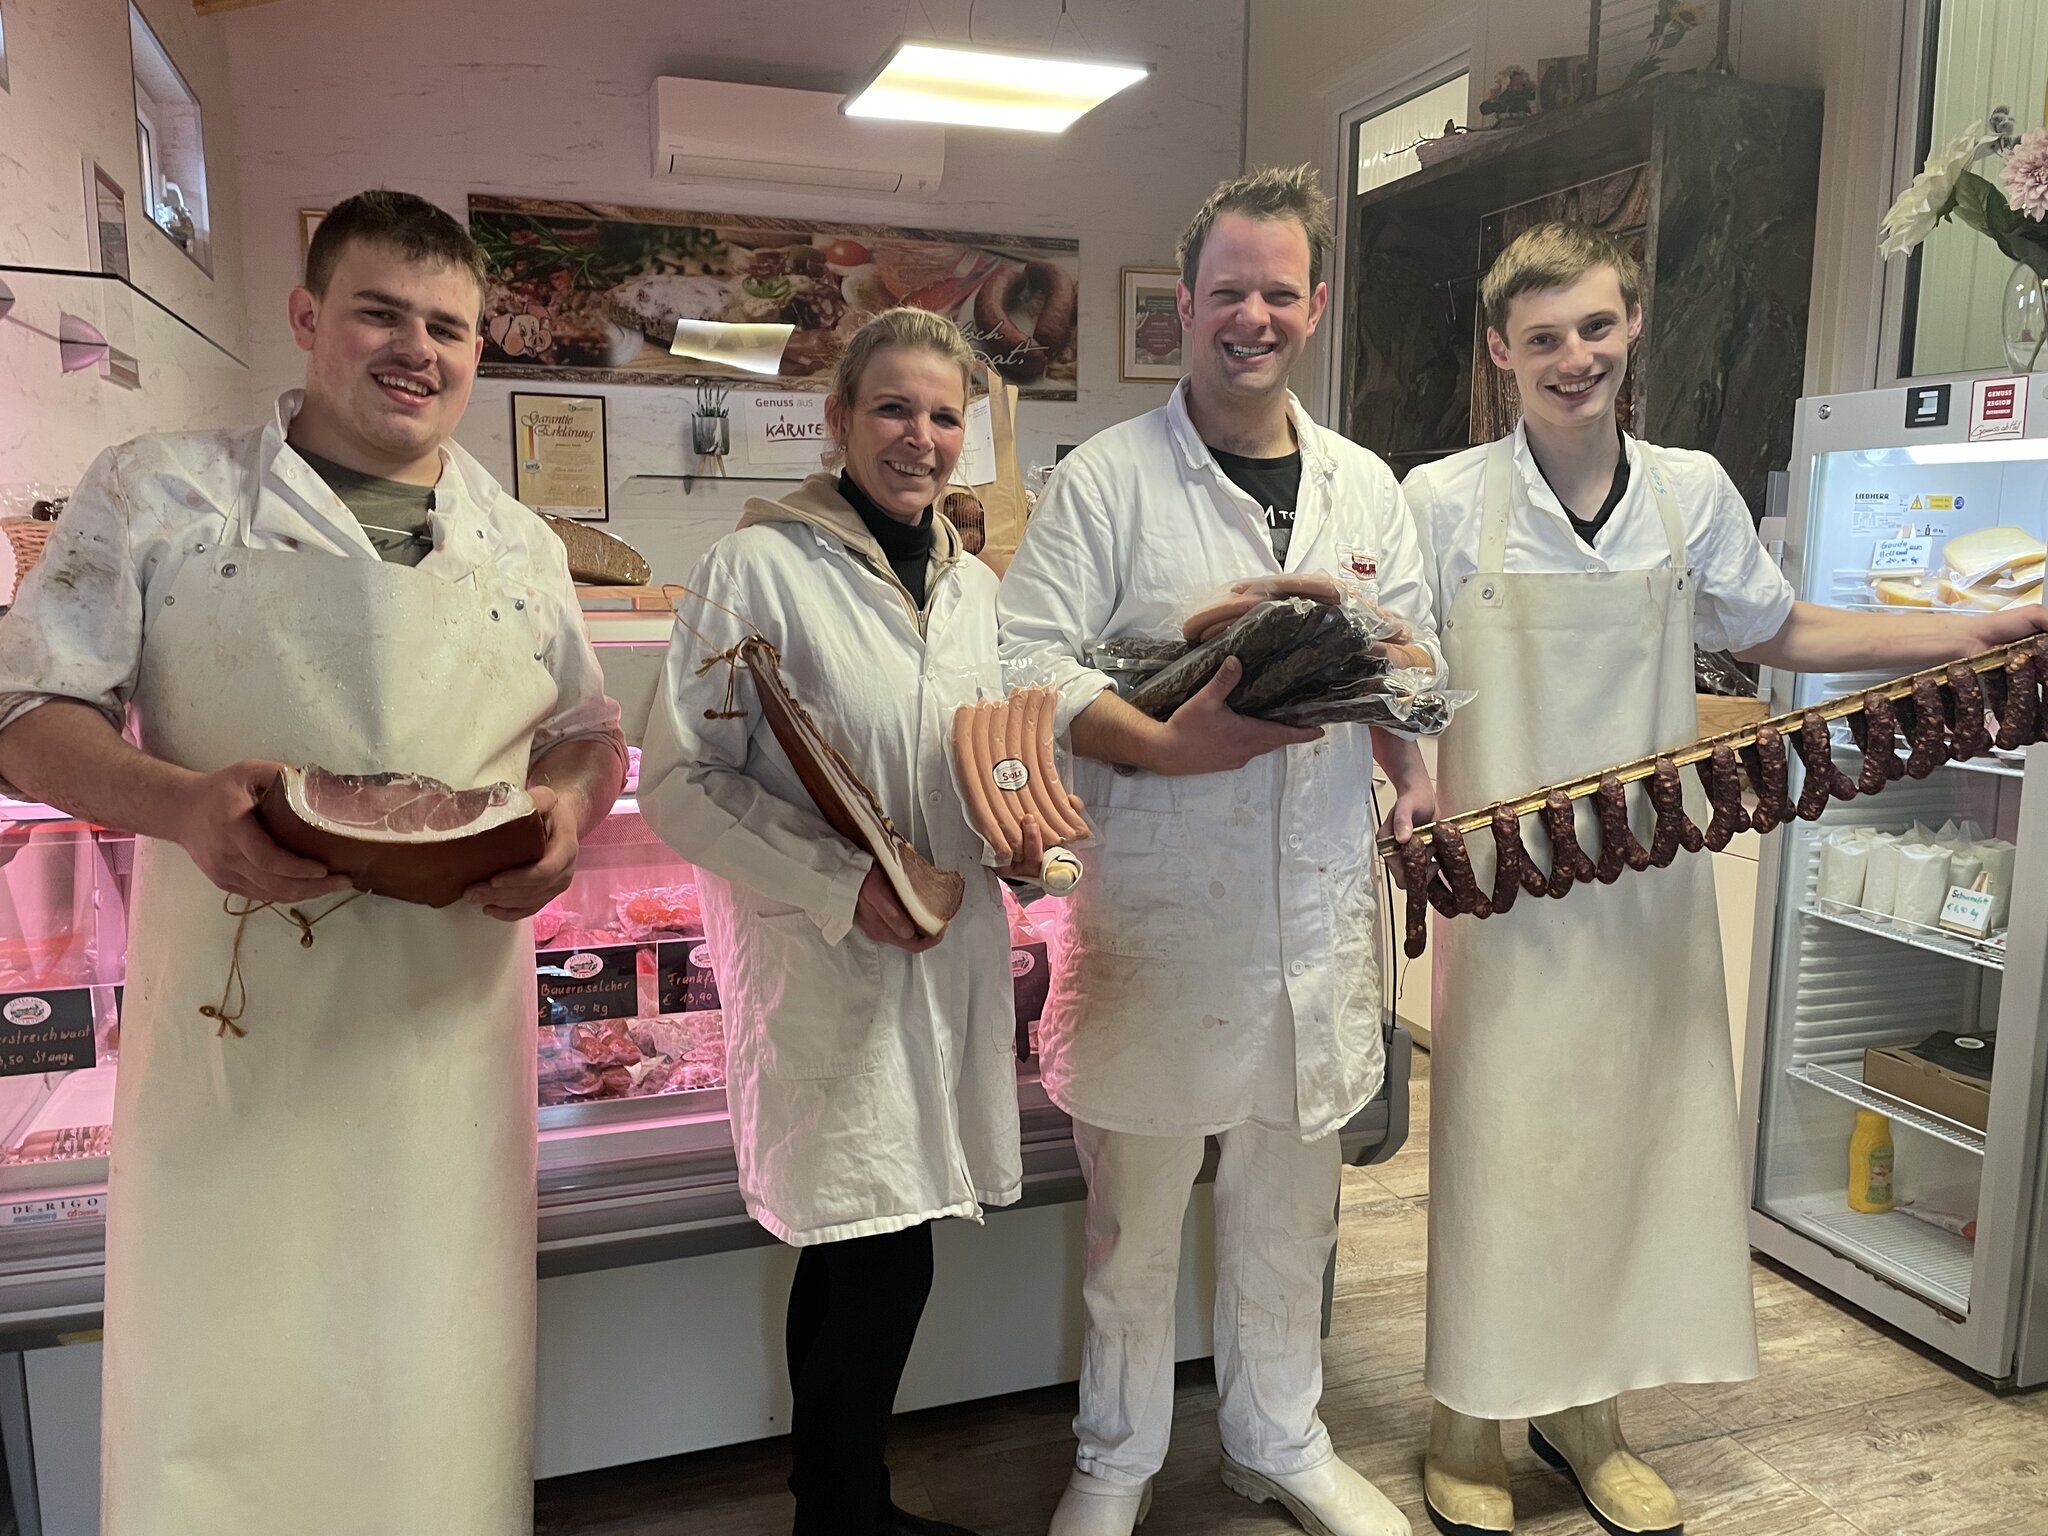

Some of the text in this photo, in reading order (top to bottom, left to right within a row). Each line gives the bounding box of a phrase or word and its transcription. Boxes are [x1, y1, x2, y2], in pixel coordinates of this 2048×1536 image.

[1987, 389, 2013, 398] GENUSS
[755, 398, 813, 408] Genuss aus
[1986, 399, 2012, 407] REGION
[521, 411, 574, 428] Garantie
[766, 413, 824, 438] KÄRNTE
[534, 424, 595, 443] Erklärung
[680, 992, 712, 1006] 13,90
[32, 1050, 75, 1066] Stange
